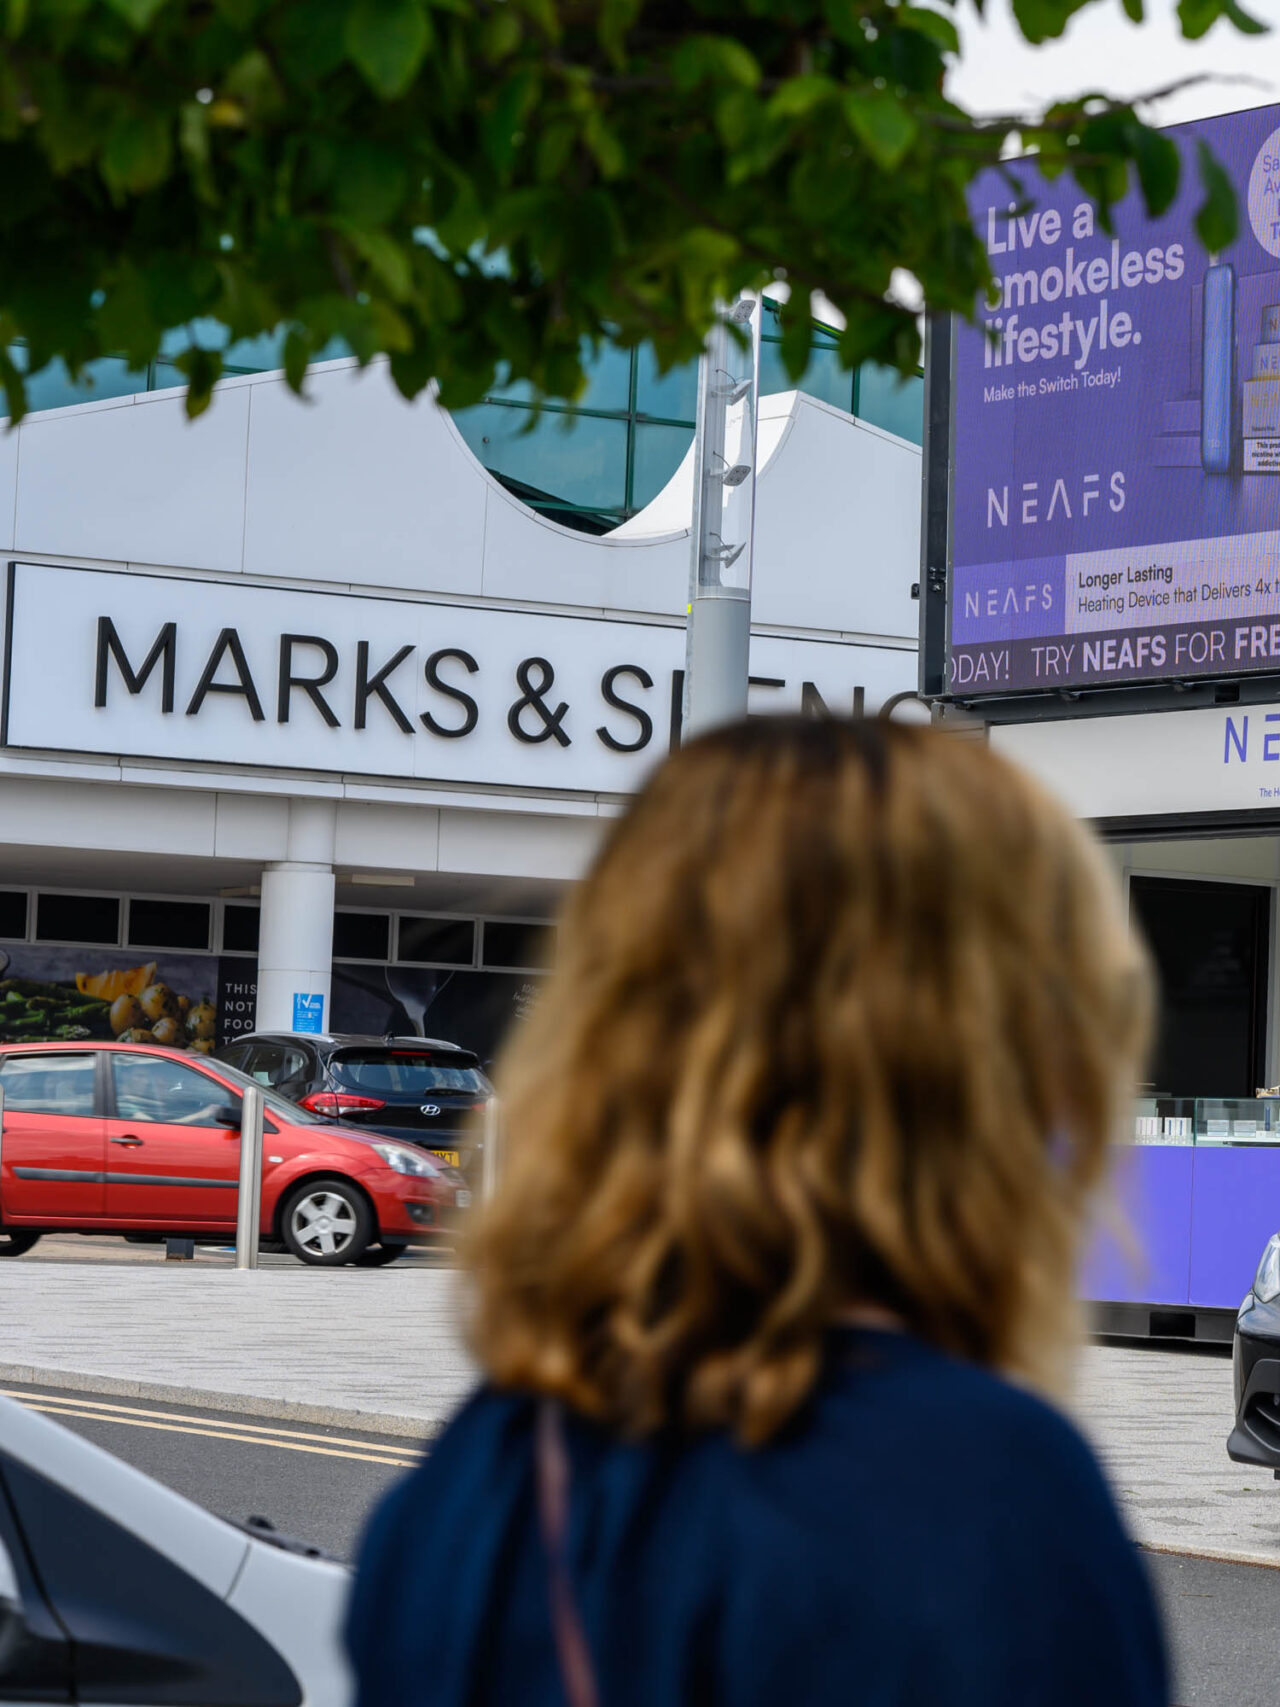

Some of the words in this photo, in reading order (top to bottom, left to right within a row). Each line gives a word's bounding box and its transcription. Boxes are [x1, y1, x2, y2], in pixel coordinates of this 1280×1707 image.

[988, 202, 1062, 255] Live
[1072, 202, 1094, 239] a
[984, 299, 1141, 370] lifestyle.
[984, 386, 1015, 403] Make
[1017, 381, 1036, 398] the
[1039, 374, 1078, 395] Switch
[1081, 366, 1121, 388] Today!
[987, 471, 1126, 528] NEAFS
[1078, 570, 1123, 590] Longer
[1127, 565, 1173, 583] Lasting
[965, 584, 1052, 618] NEAFS
[1078, 593, 1124, 614] Heating
[1128, 590, 1169, 608] Device
[1174, 586, 1197, 604] that
[1201, 580, 1251, 601] Delivers
[1255, 578, 1271, 595] 4x
[1031, 644, 1075, 677] TRY
[1082, 634, 1166, 673] NEAFS
[1175, 631, 1226, 665] FOR
[95, 615, 481, 739] MARKS
[507, 656, 572, 747] &
[1259, 787, 1272, 798] The
[224, 1001, 254, 1013] NOT
[225, 983, 257, 995] THIS
